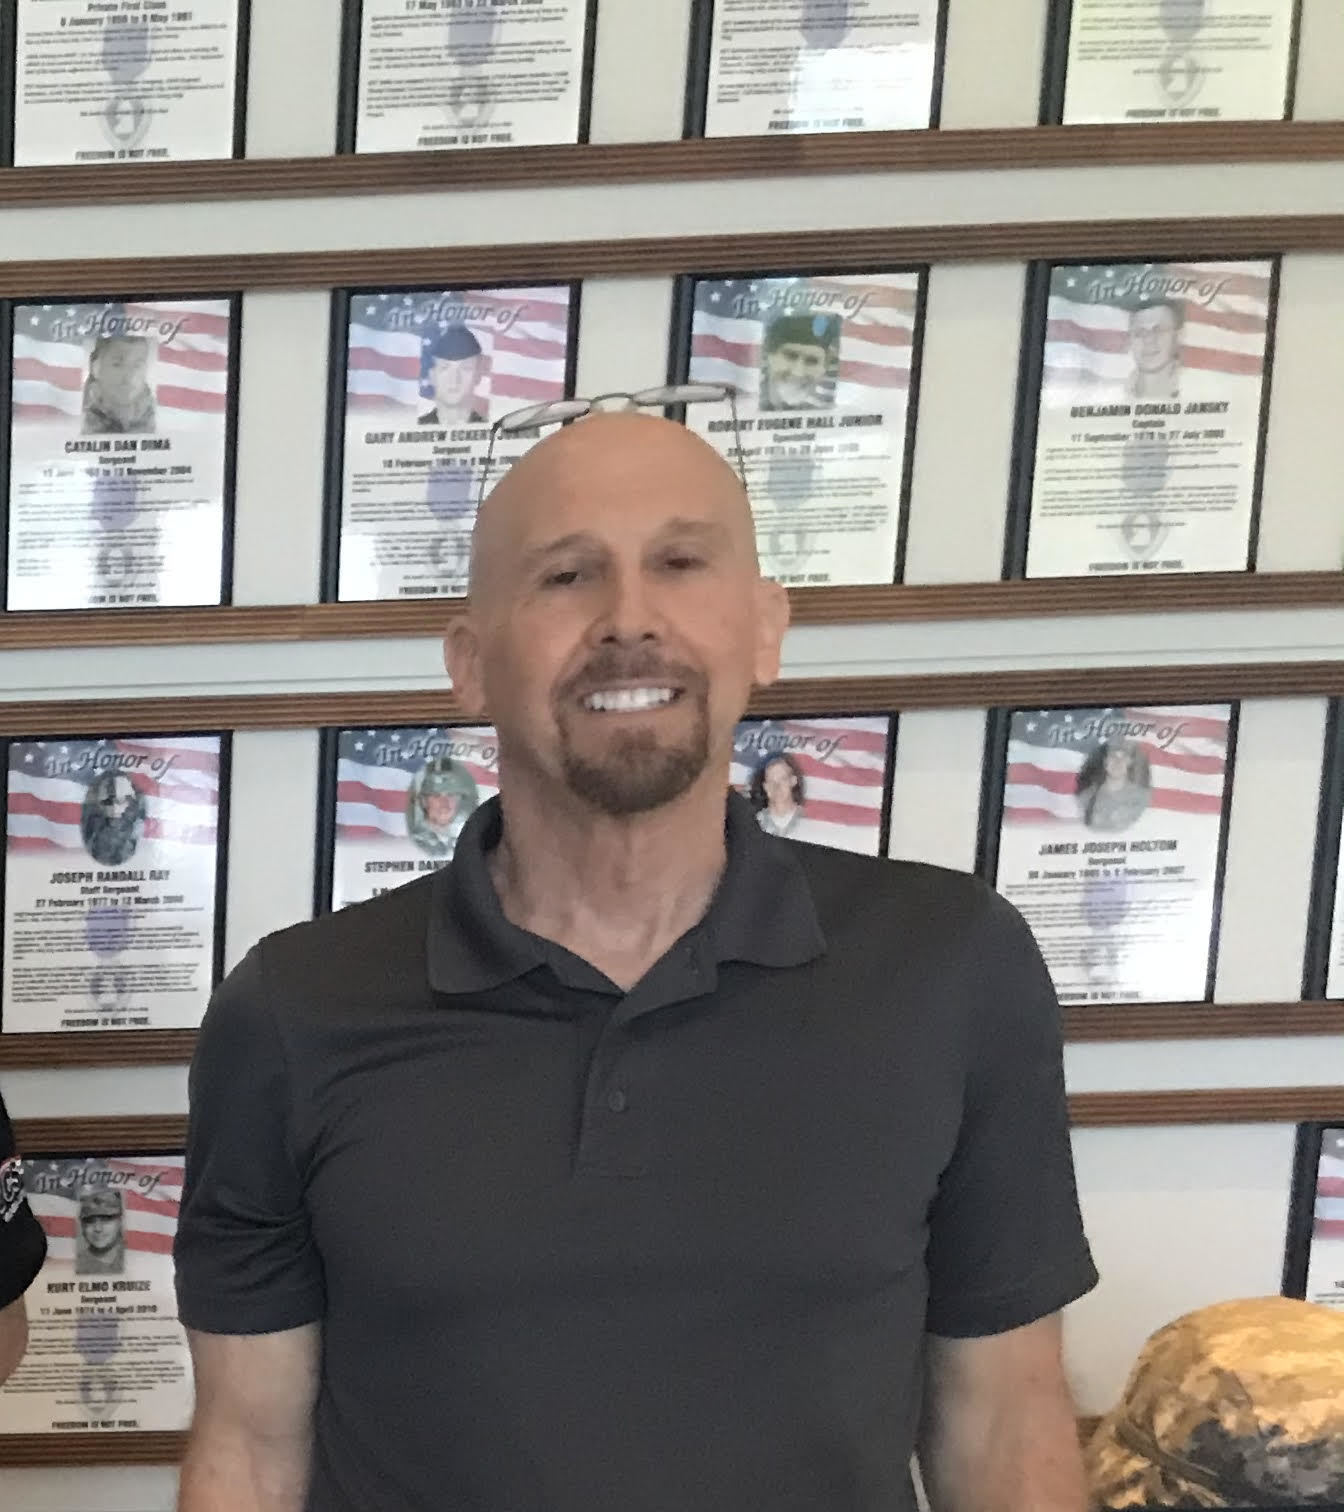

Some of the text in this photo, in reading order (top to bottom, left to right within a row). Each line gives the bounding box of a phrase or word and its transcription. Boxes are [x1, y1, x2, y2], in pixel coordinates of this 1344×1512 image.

[159, 318, 189, 344] of
[1084, 717, 1191, 748] Honor of
[410, 737, 479, 758] Honor
[79, 748, 179, 779] Honor of
[50, 872, 93, 884] JOSEPH
[37, 1165, 169, 1194] In Honor of
[47, 1282, 75, 1294] KURT
